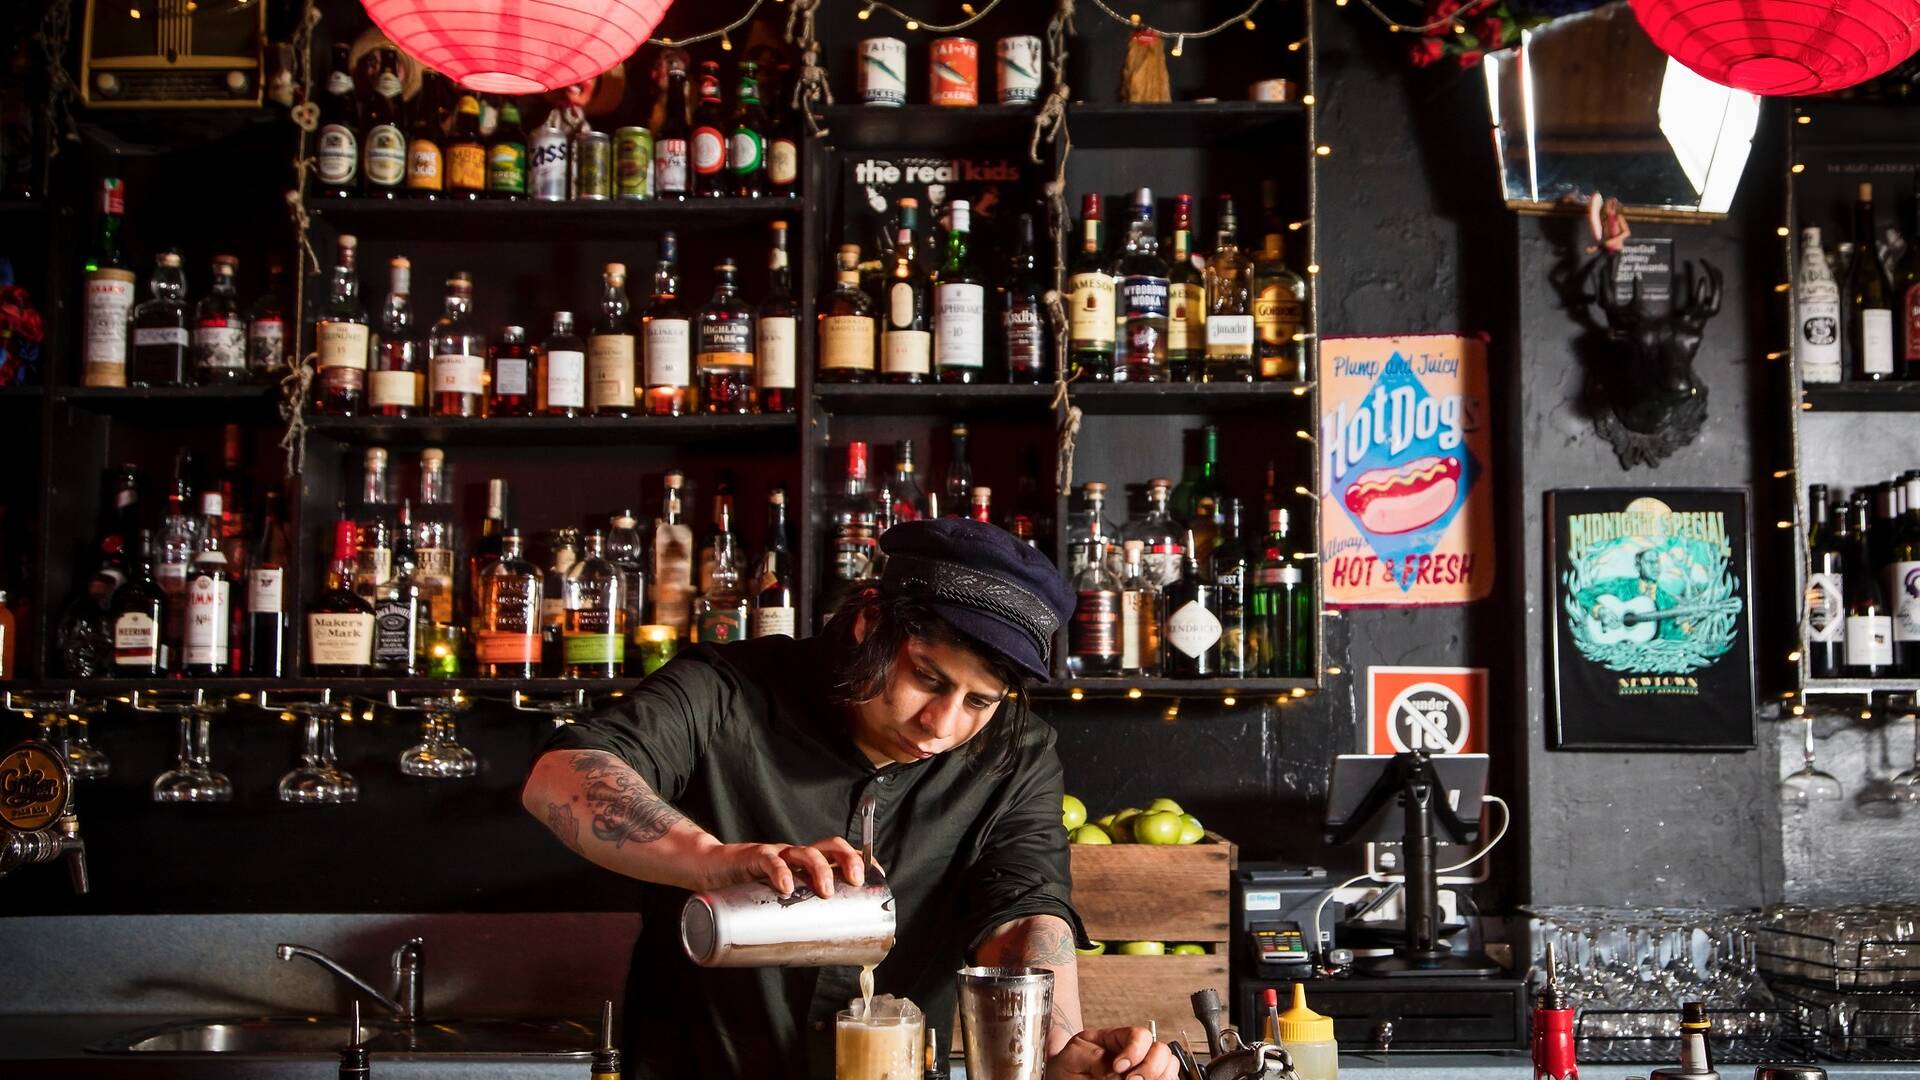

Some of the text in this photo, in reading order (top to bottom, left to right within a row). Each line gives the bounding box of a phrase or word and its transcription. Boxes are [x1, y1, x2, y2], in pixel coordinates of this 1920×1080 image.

[856, 158, 1020, 184] the real kids
[1131, 295, 1161, 306] WODKA
[703, 324, 749, 335] HIGHLAND
[713, 334, 738, 343] PARK
[1334, 352, 1460, 381] Plump and Juicy
[1568, 511, 1732, 560] MIDNIGHT SPECIAL
[1332, 553, 1476, 587] HOT & FRESH
[314, 618, 363, 628] Maker's
[328, 629, 362, 638] Mark
[1410, 697, 1449, 711] under
[1405, 710, 1449, 750] 18
